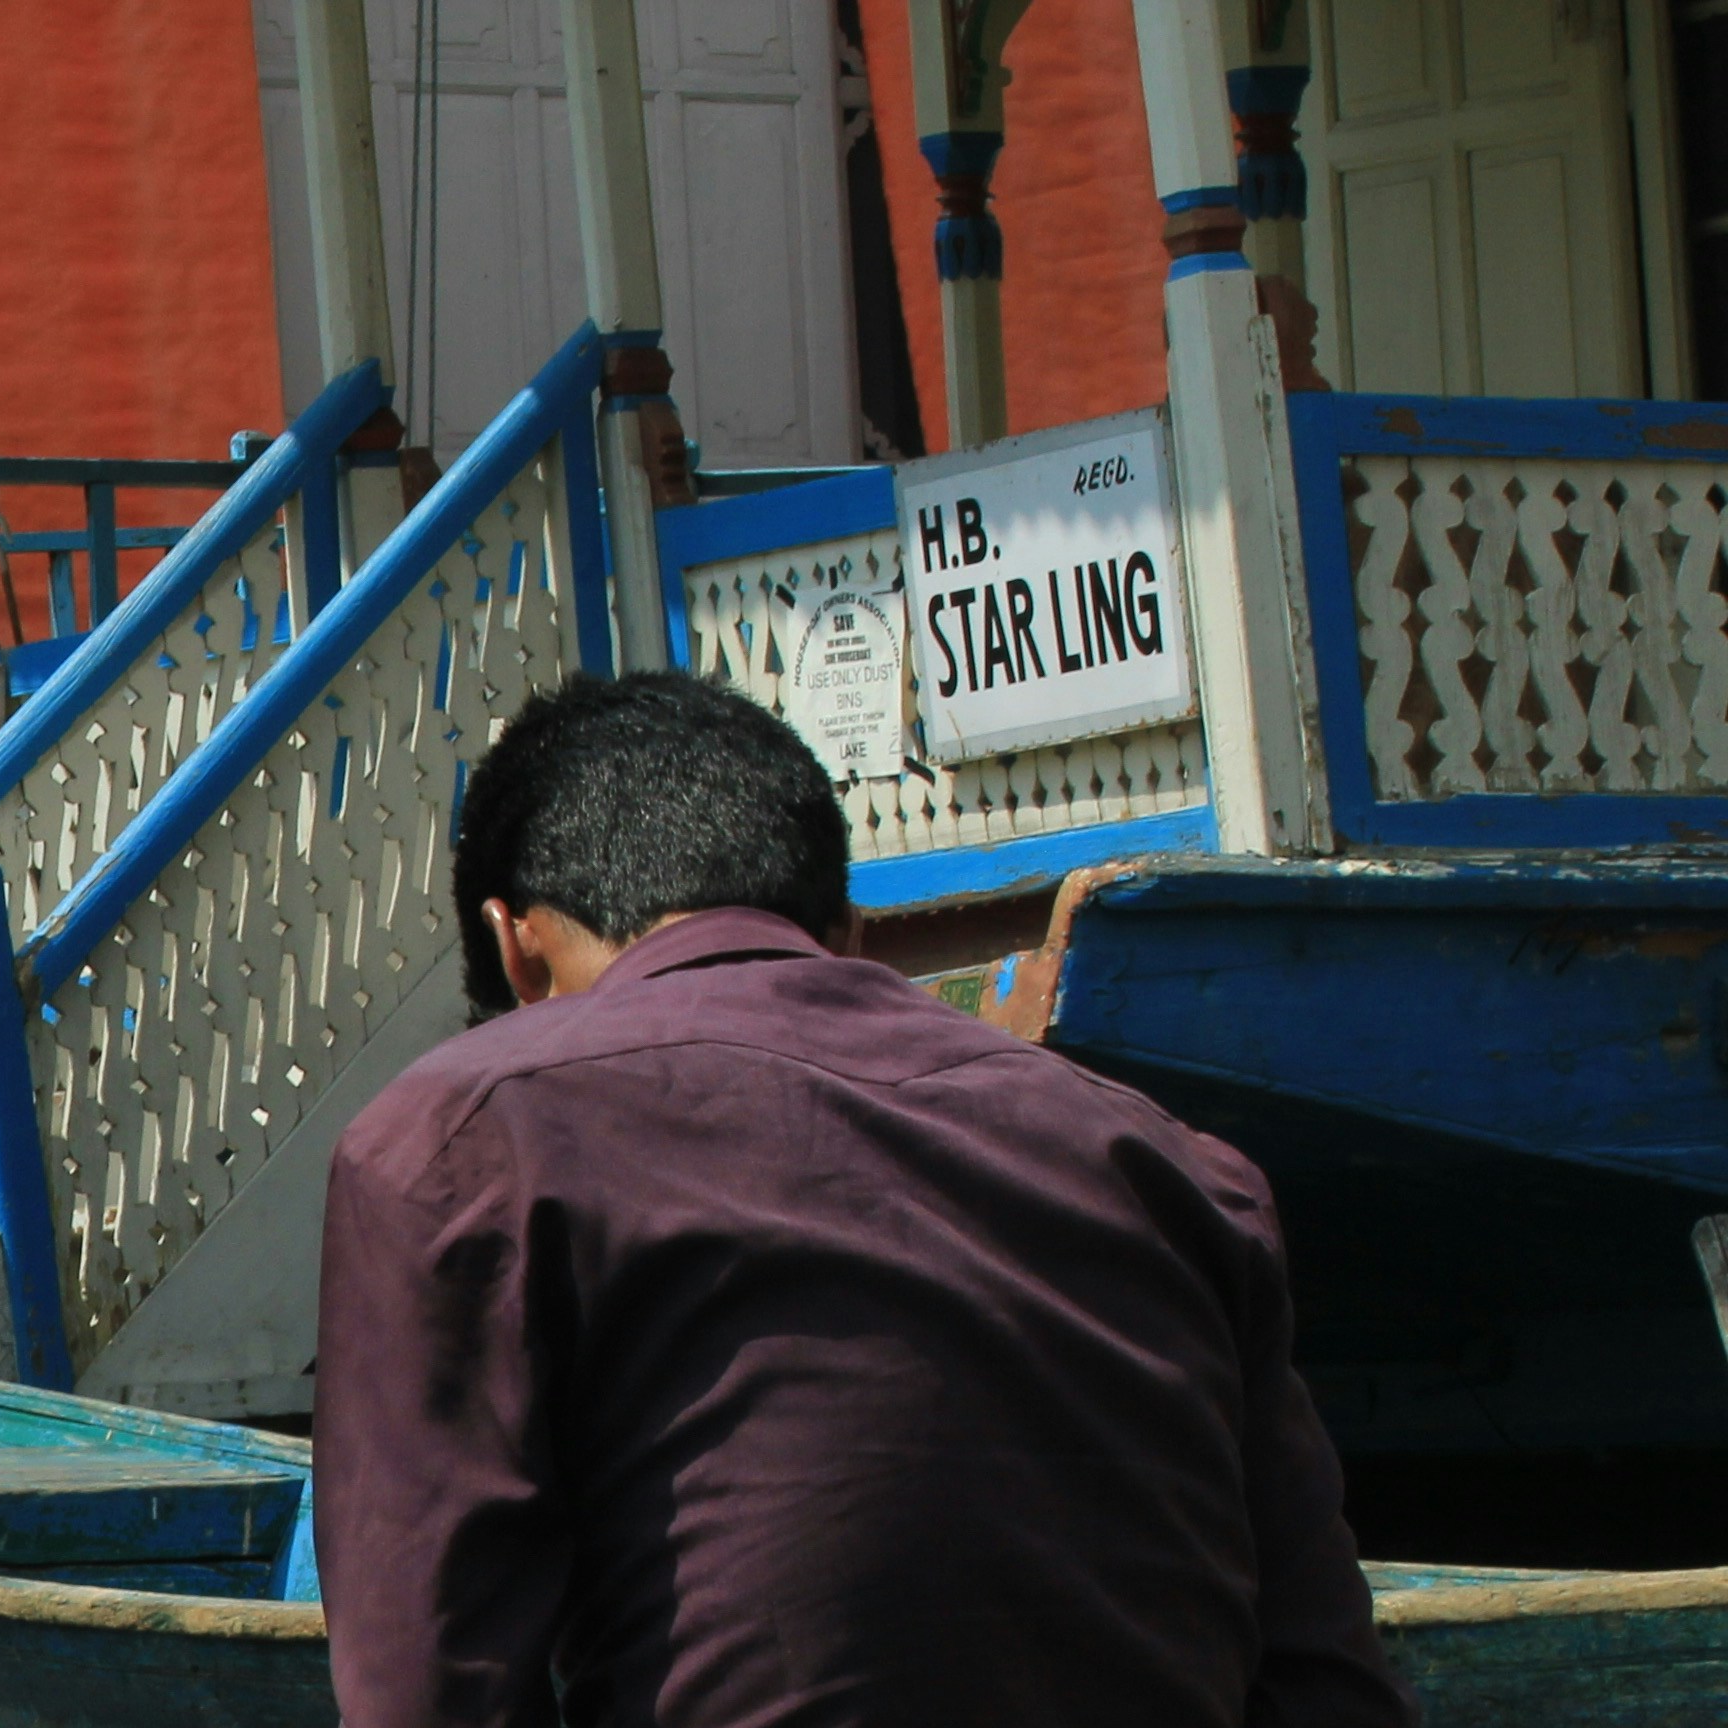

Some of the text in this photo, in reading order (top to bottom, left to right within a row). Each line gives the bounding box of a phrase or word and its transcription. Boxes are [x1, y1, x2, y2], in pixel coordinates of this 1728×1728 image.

[1072, 453, 1135, 496] REGD.
[918, 497, 1001, 574] H.B.
[807, 663, 894, 689] USE ONLY DUST
[836, 692, 863, 710] BINS
[840, 741, 867, 760] LAKE
